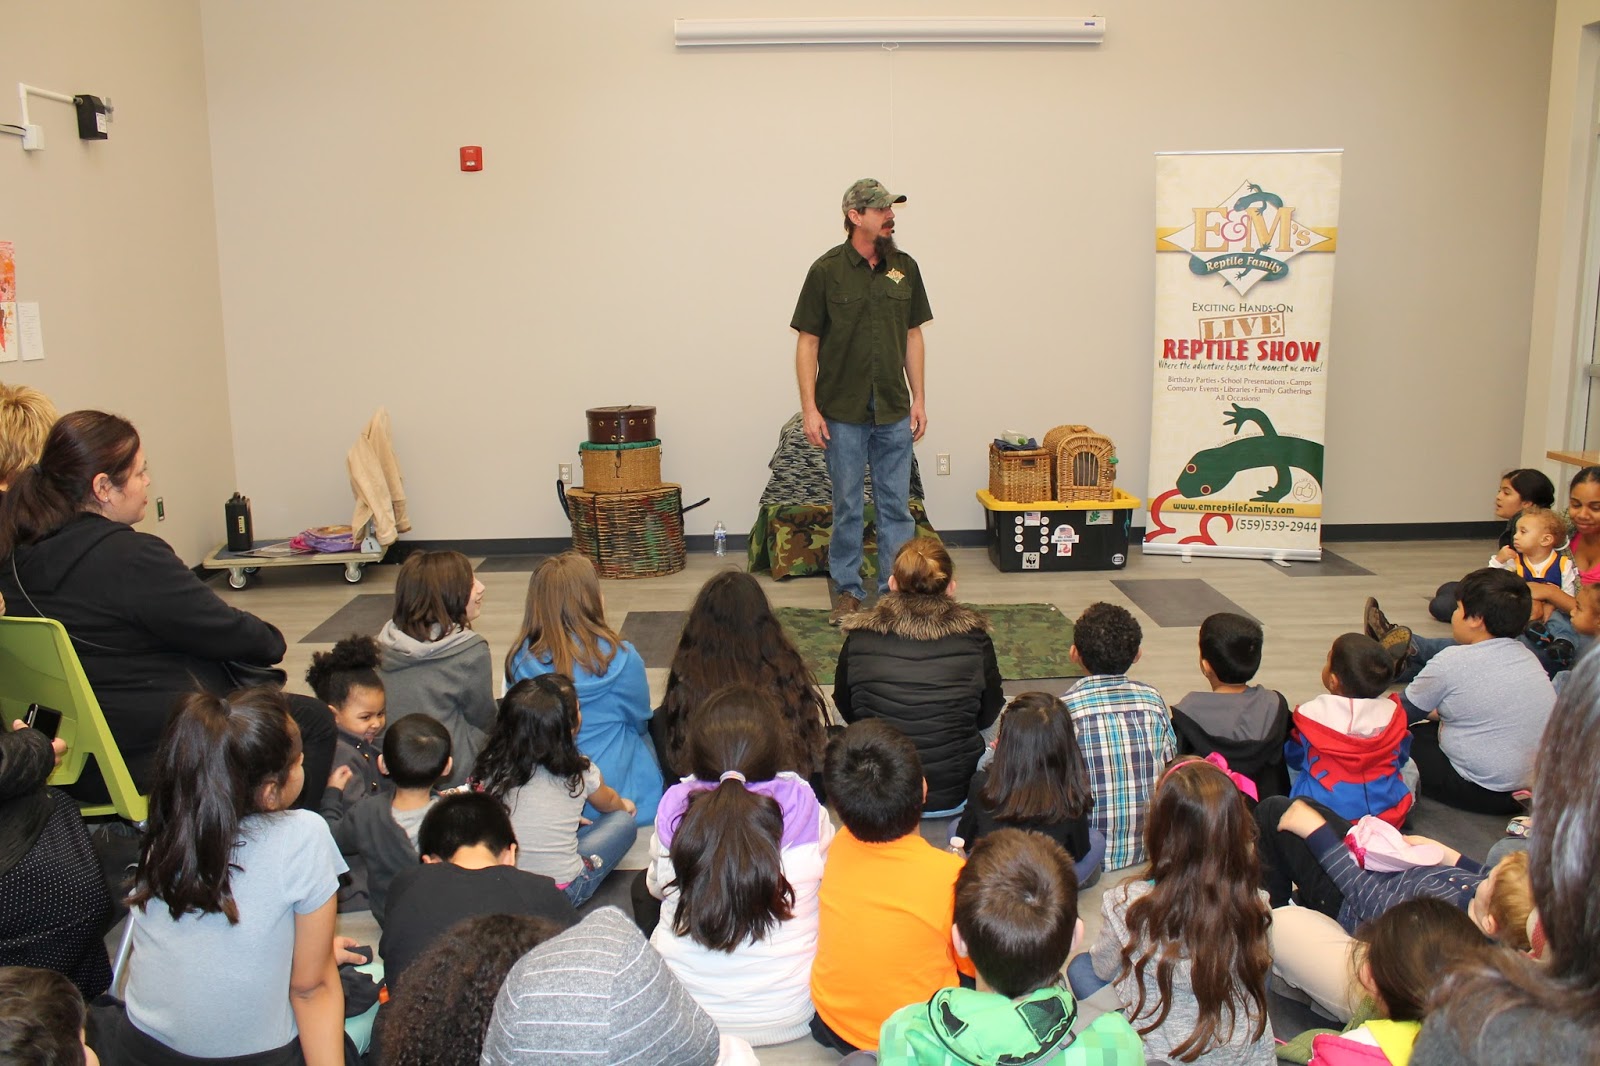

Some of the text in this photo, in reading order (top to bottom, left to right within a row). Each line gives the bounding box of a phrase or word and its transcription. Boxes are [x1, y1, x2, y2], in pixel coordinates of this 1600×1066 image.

[1206, 256, 1283, 273] Reptile Family
[1202, 315, 1281, 340] LIVE
[1163, 339, 1321, 362] REPTILE SHOW
[1158, 360, 1177, 369] Where
[1180, 361, 1190, 370] the
[1192, 360, 1224, 371] adventure
[1226, 361, 1247, 371] begins
[1248, 362, 1259, 371] the
[1300, 362, 1323, 373] arrive!
[1167, 376, 1194, 384] Birthday
[1243, 378, 1285, 386] Presentations
[1289, 379, 1312, 387] Camps
[1167, 385, 1197, 393] Company
[1277, 387, 1312, 395] Gatherings
[1173, 502, 1295, 515] www.emreptilefamily.com
[1235, 517, 1318, 533] (559)539-2944
